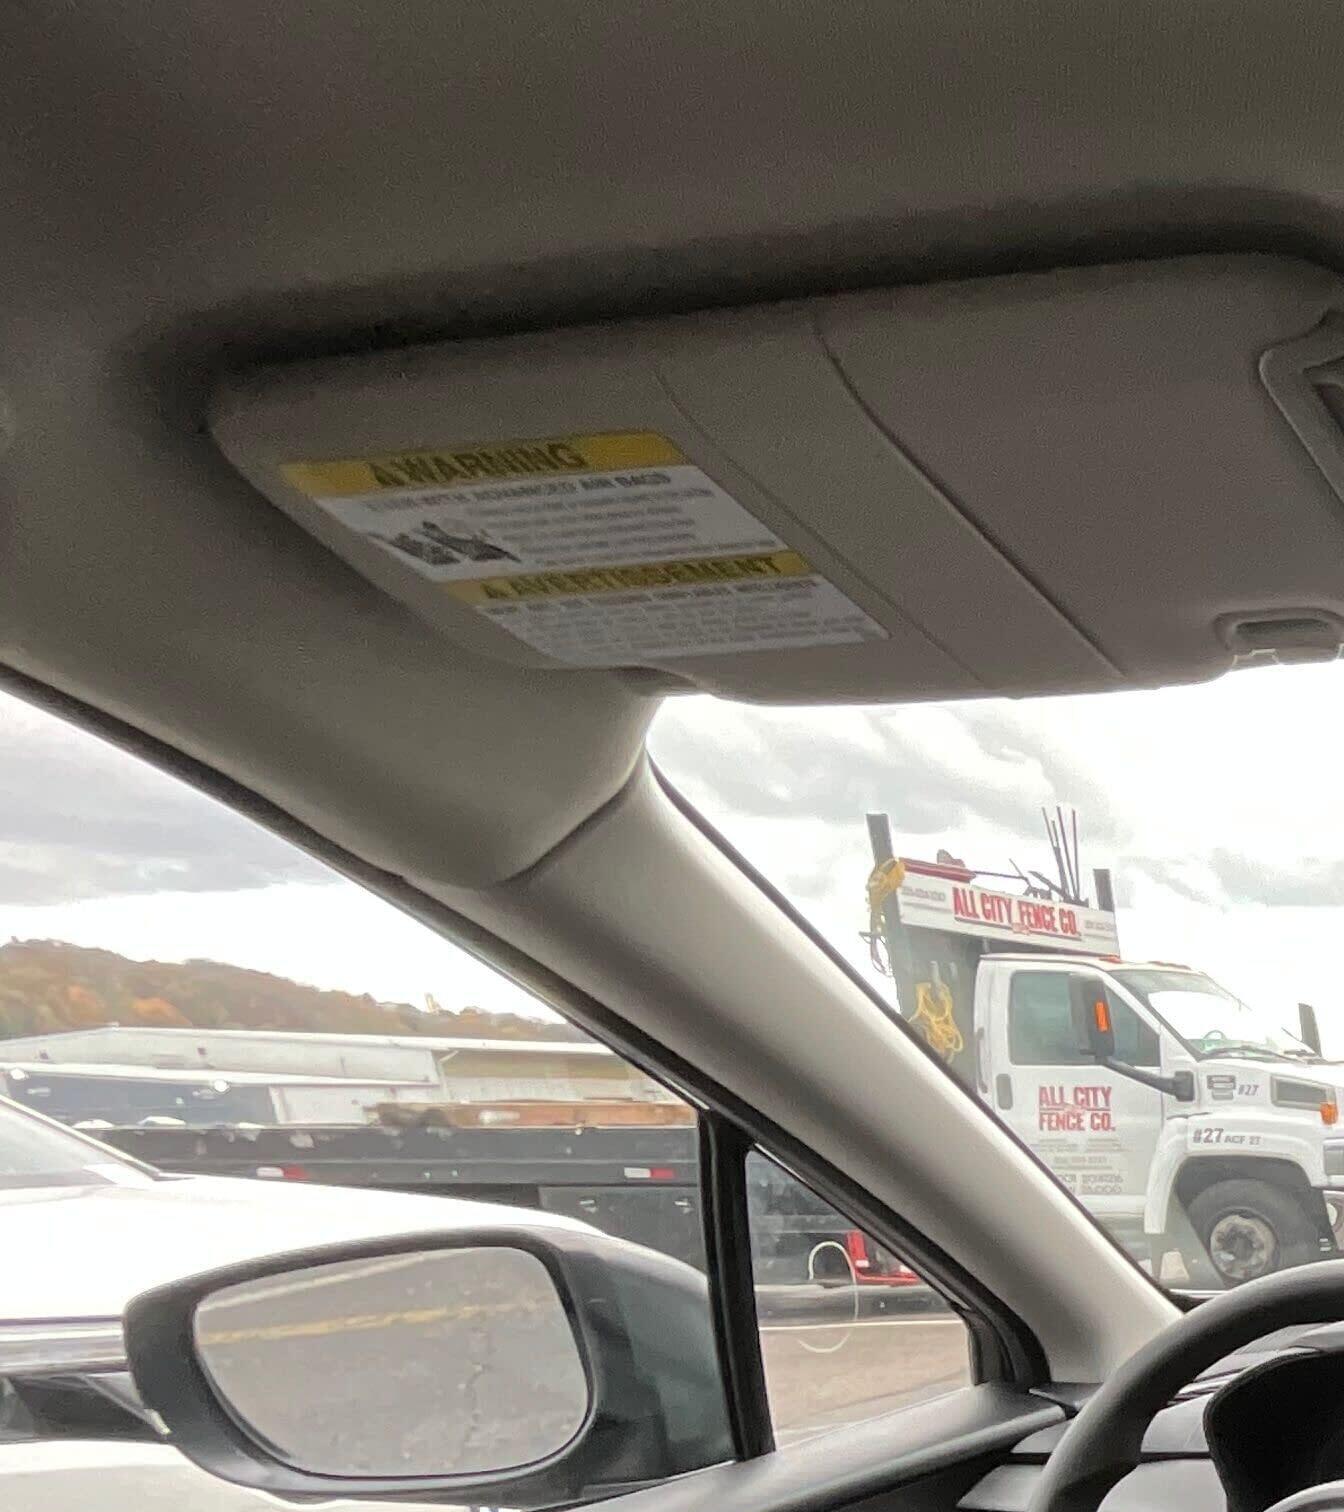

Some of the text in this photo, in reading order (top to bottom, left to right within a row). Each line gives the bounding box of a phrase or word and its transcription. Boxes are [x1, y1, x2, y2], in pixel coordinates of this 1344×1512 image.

[391, 442, 589, 483] WARNING
[953, 887, 979, 919] ALL
[981, 892, 1013, 924] CITY
[1017, 899, 1057, 933] FENCE
[1059, 905, 1082, 937] CO.
[1039, 1086, 1112, 1107] ALL CITY
[1039, 1112, 1116, 1131] FENCE CO.
